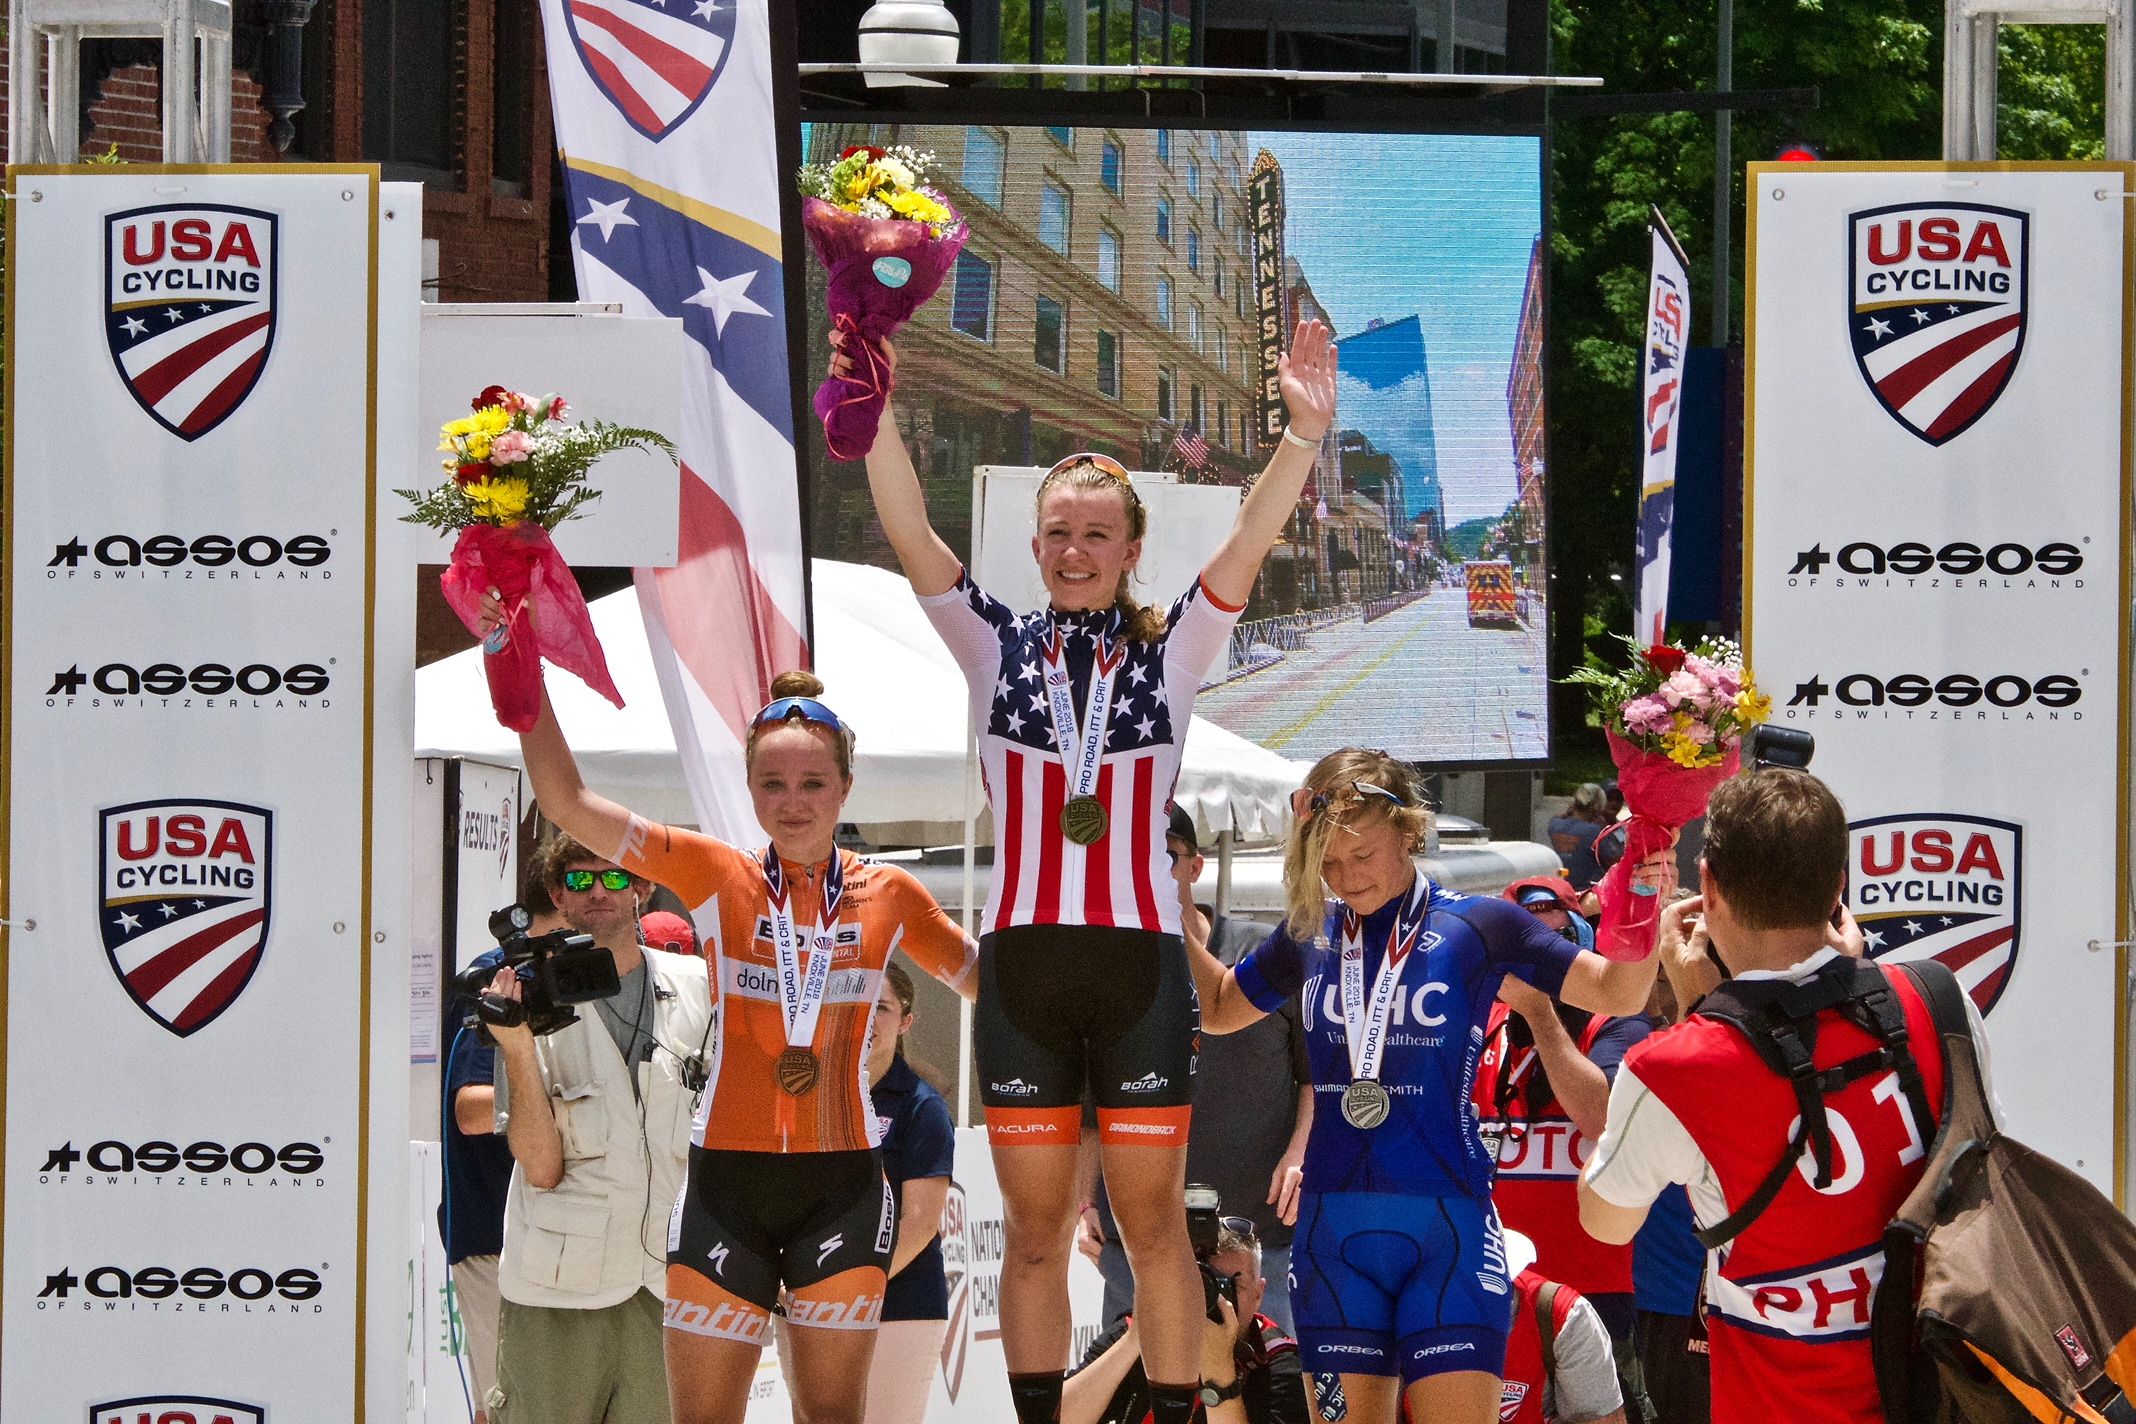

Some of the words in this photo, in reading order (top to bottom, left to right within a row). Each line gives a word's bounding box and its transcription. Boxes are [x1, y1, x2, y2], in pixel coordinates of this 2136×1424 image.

[122, 218, 261, 267] USA
[1867, 217, 2012, 268] USA
[122, 269, 261, 293] CYCLING
[1866, 268, 2011, 294] CYCLING
[1255, 174, 1284, 436] TENNESSEE
[94, 535, 330, 566] assos
[1837, 543, 2083, 575] assos
[48, 571, 75, 579] OF
[93, 571, 331, 579] SWITZERLAND
[1789, 579, 1816, 587] OF
[1837, 579, 2083, 588] SWITZERLAND
[93, 664, 329, 695] assos
[1095, 680, 1107, 702] CRIT
[1835, 674, 2081, 707] assos
[46, 699, 73, 708] OF
[92, 699, 329, 708] SWITZERLAND
[1059, 687, 1070, 711] JUNE
[1092, 702, 1103, 713] &
[1063, 712, 1074, 733] 2018
[1787, 710, 1815, 719] OF
[1835, 711, 2082, 720] SWITZERLAND
[1061, 738, 1070, 751] TN
[1083, 734, 1099, 770] ROAD,
[1079, 770, 1091, 795] PRO
[116, 815, 255, 865] USA
[463, 811, 498, 851] RESULTS
[1860, 829, 2004, 880] USA
[116, 865, 255, 889] CYCLING
[1860, 879, 2004, 906] CYCLING
[776, 914, 789, 938] CRIT
[817, 955, 828, 977] JUNE
[1352, 966, 1360, 985] JUNE
[783, 968, 797, 1003] ROAD,
[813, 978, 823, 1000] 2018
[1353, 985, 1361, 1006] 2018
[800, 1002, 810, 1014] TN
[1348, 1011, 1356, 1023] TN
[1365, 1025, 1381, 1060] ROAD,
[1379, 970, 1394, 994] CRIT
[1120, 1077, 1169, 1091] Borah
[1351, 1087, 1379, 1096] USA
[997, 1124, 1058, 1133] ACURA
[87, 1140, 325, 1174] assos
[40, 1176, 67, 1184] OF
[86, 1176, 324, 1186] SWITZERLAND
[85, 1266, 323, 1300] assos
[37, 1301, 64, 1310] OF
[83, 1302, 322, 1313] SWITZERLAND
[1317, 1344, 1384, 1357] ORBEA
[1414, 1342, 1476, 1360] ORBEA
